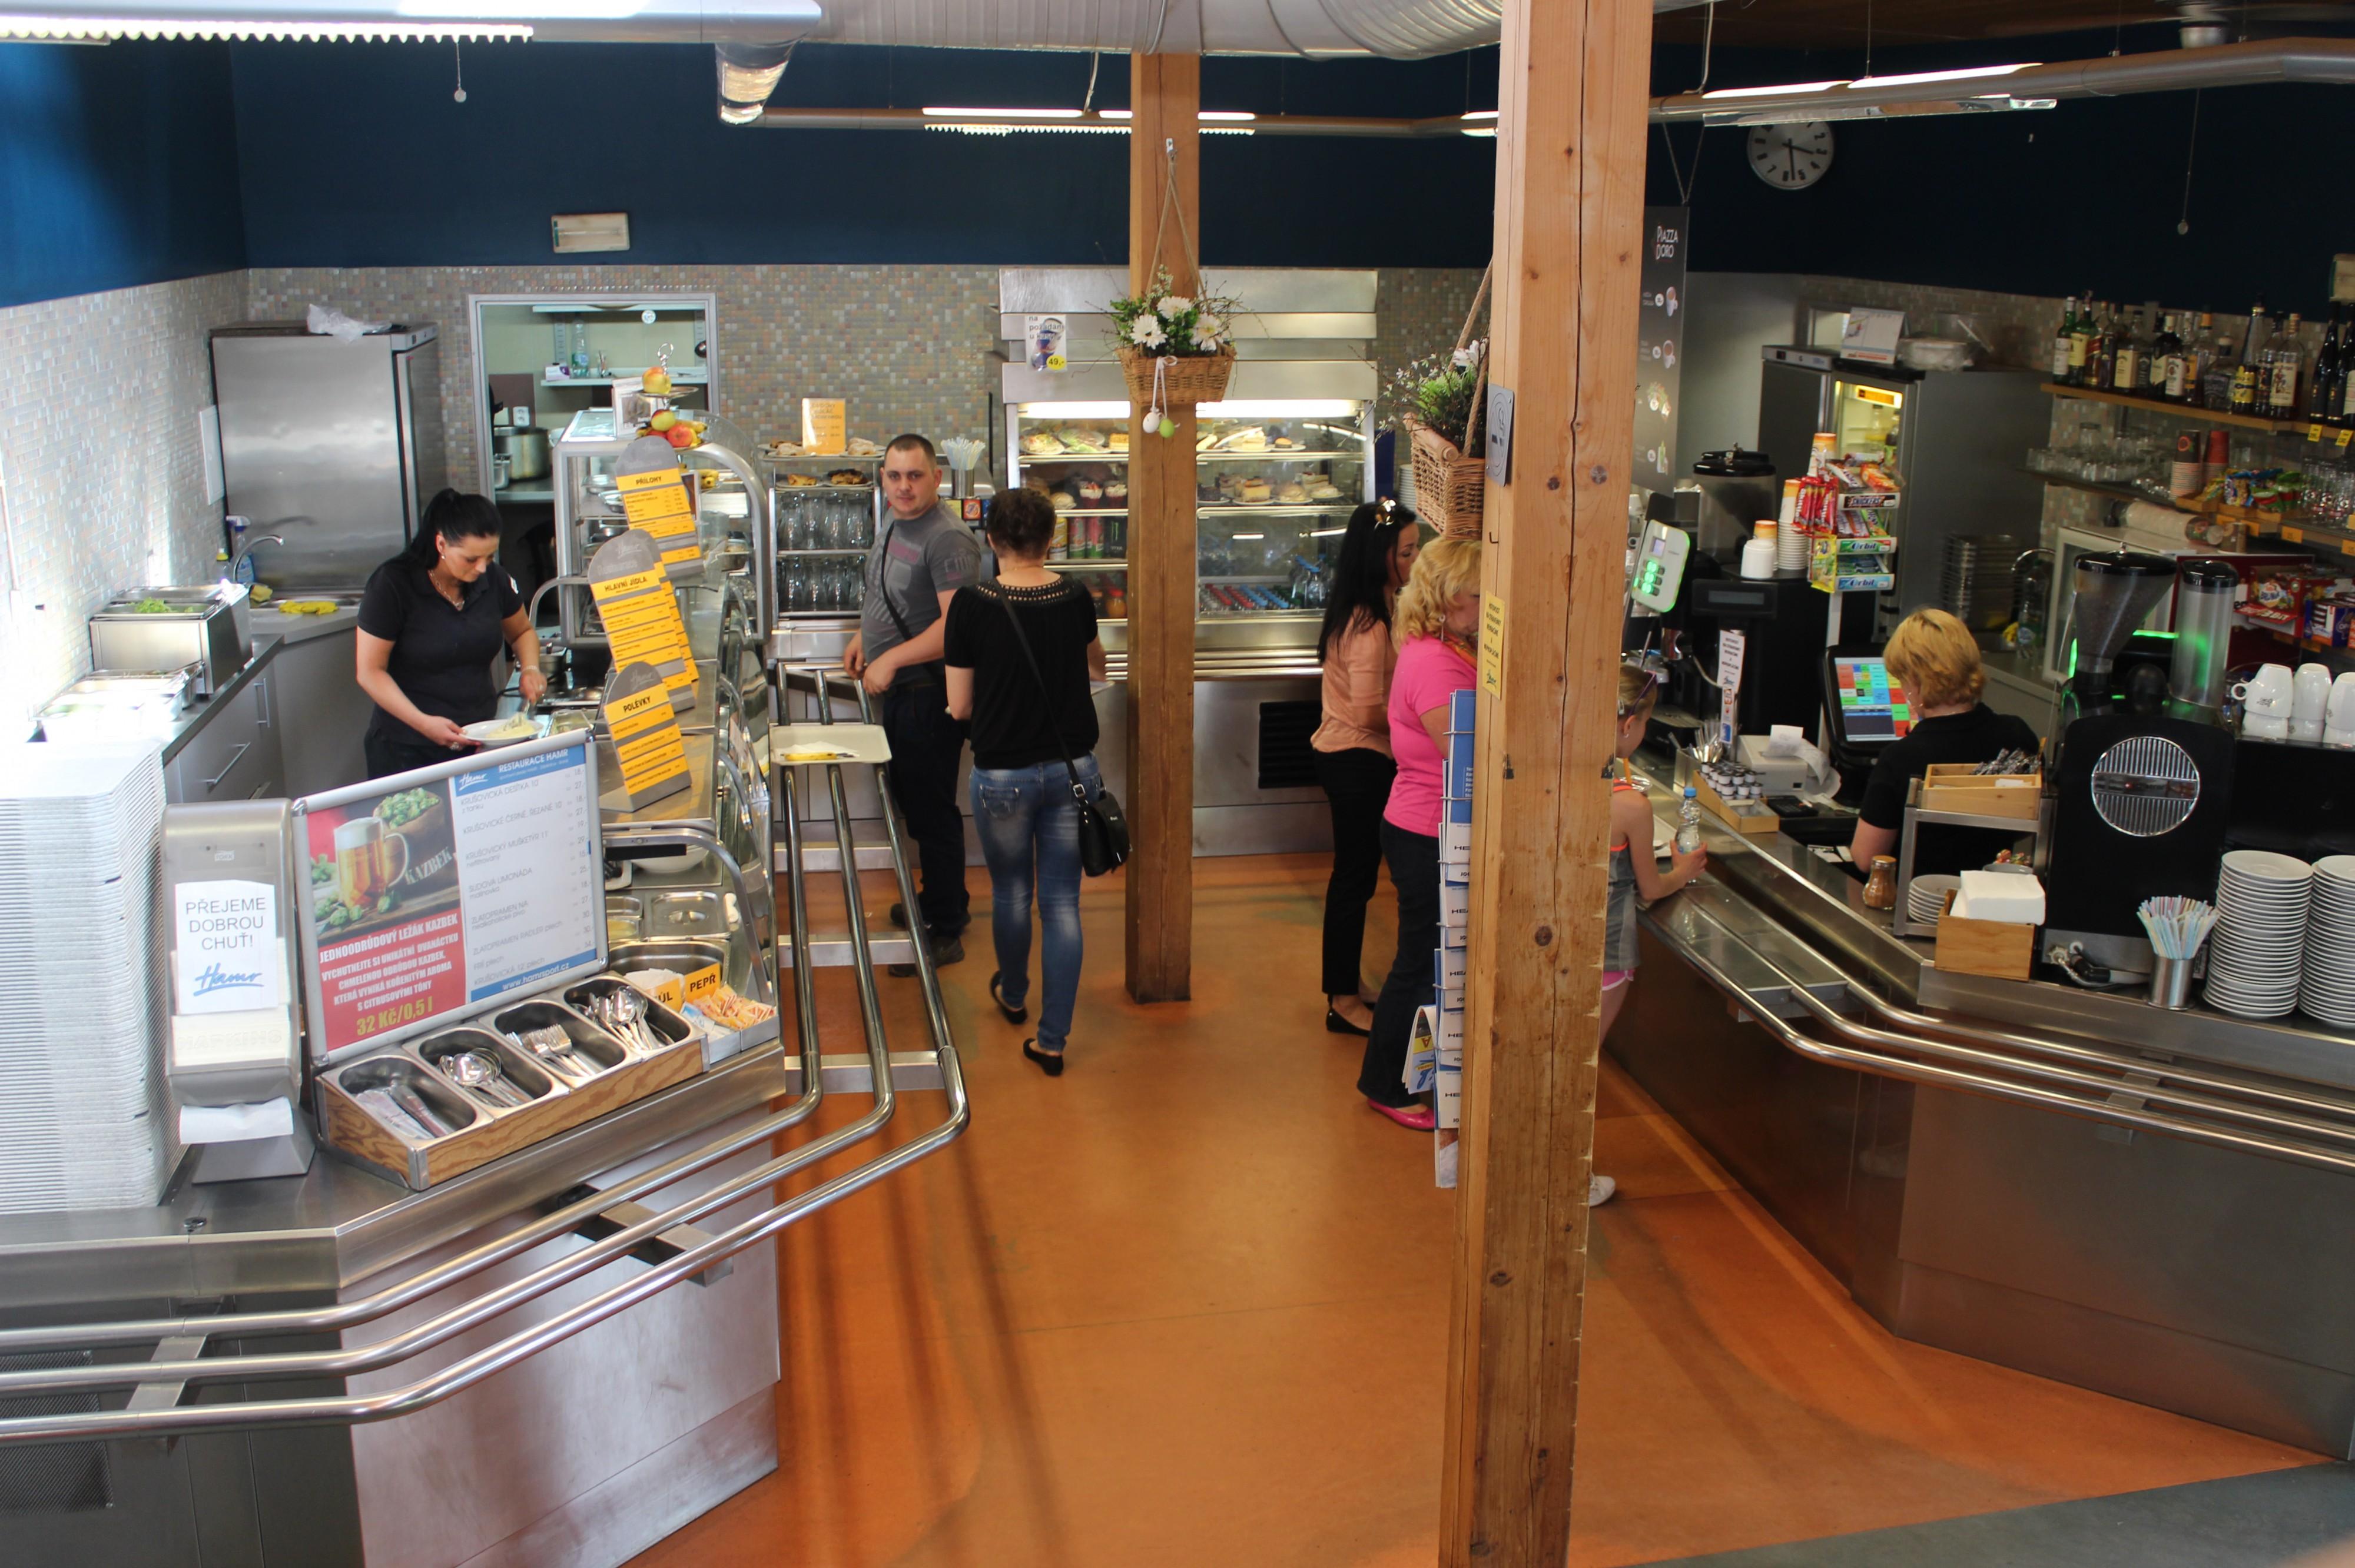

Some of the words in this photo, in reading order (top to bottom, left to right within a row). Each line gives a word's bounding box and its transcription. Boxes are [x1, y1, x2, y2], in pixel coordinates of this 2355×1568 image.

[1049, 357, 1064, 366] 49,-
[635, 476, 662, 486] PŘÍLOHY
[1852, 542, 1876, 550] Orbit
[604, 580, 628, 592] HLAVNÍ
[629, 576, 648, 586] JÍDLA
[1850, 577, 1875, 586] Orbit
[623, 696, 651, 712] POLÉVKY
[499, 754, 545, 773] RESTAURACE
[546, 748, 569, 761] HAMR
[404, 846, 453, 885] KAZBEK
[186, 896, 266, 915] PŘEJEME
[189, 915, 264, 933] DOBROU
[201, 932, 253, 951] CHUŤ!
[320, 929, 398, 964] JEDNOODRŮDOVÝ
[399, 922, 424, 941] LEŽÁK
[425, 913, 458, 932] KAZBEK
[193, 962, 264, 996] Hamr
[321, 959, 372, 982] VYCHUTNEJTE
[372, 956, 380, 966] SI
[502, 962, 569, 991] www.hamrsport.cz
[334, 988, 357, 1006] KTERÁ
[427, 961, 452, 976] AROMA
[339, 969, 382, 991] CHMELENOU
[689, 973, 716, 992] PEPŘ
[357, 1002, 363, 1012] S
[364, 986, 413, 1009] CITRUSOVÝMI
[414, 980, 432, 994] TÓNY
[356, 1014, 375, 1036] 32
